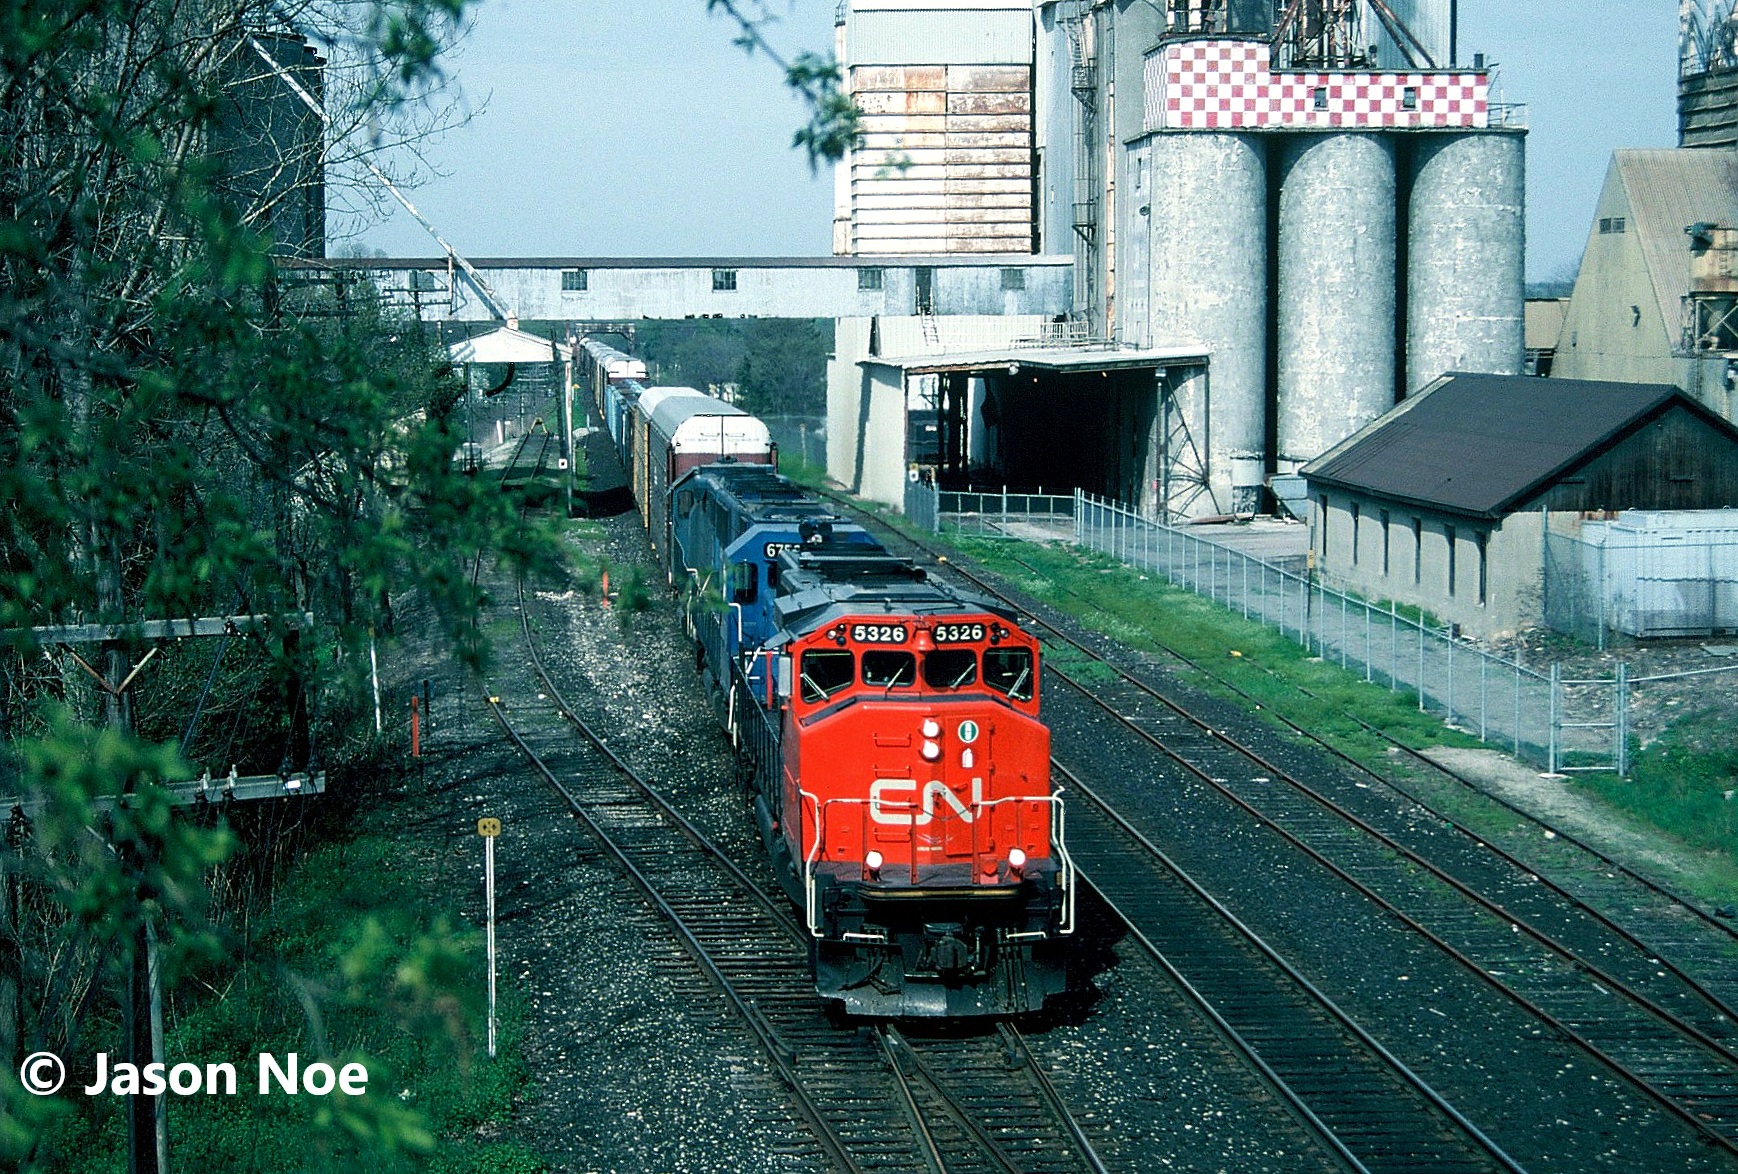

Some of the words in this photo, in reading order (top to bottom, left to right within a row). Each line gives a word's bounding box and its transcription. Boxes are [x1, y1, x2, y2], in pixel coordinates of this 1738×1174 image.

[854, 625, 904, 642] 5326
[935, 624, 983, 641] 5326
[869, 777, 982, 825] CN
